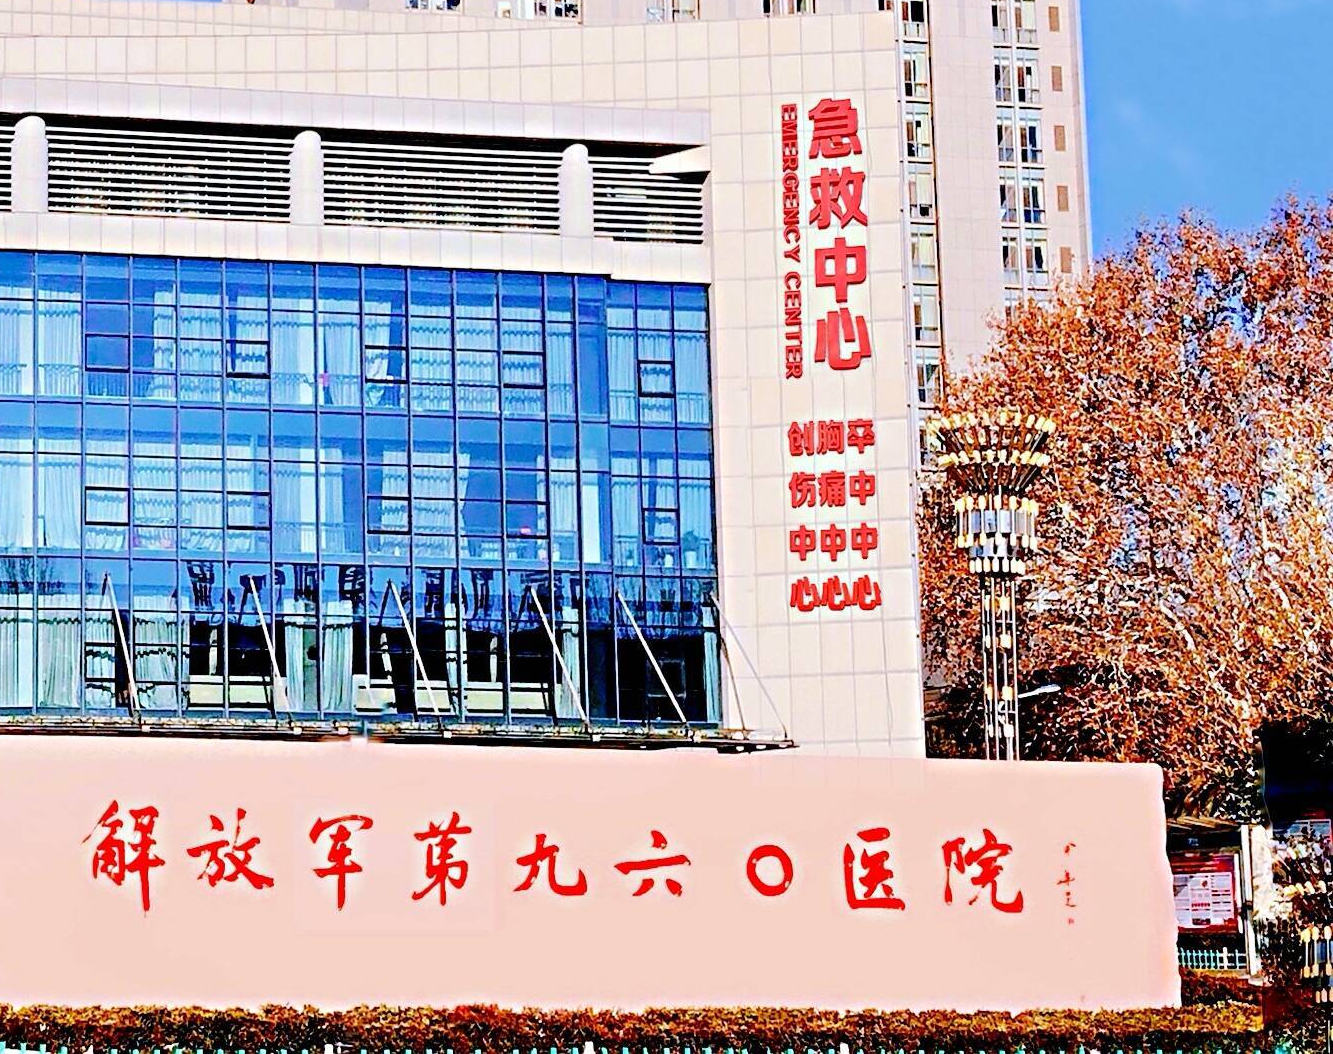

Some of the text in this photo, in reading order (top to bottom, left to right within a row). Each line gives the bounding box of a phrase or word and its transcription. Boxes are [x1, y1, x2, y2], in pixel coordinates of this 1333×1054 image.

[781, 103, 803, 380] EMERGENCY CENTER
[808, 98, 872, 371] 急救中心
[788, 421, 820, 612] 创伤中心
[817, 419, 851, 611] 胸痛中心
[847, 418, 882, 611] 卒中中心
